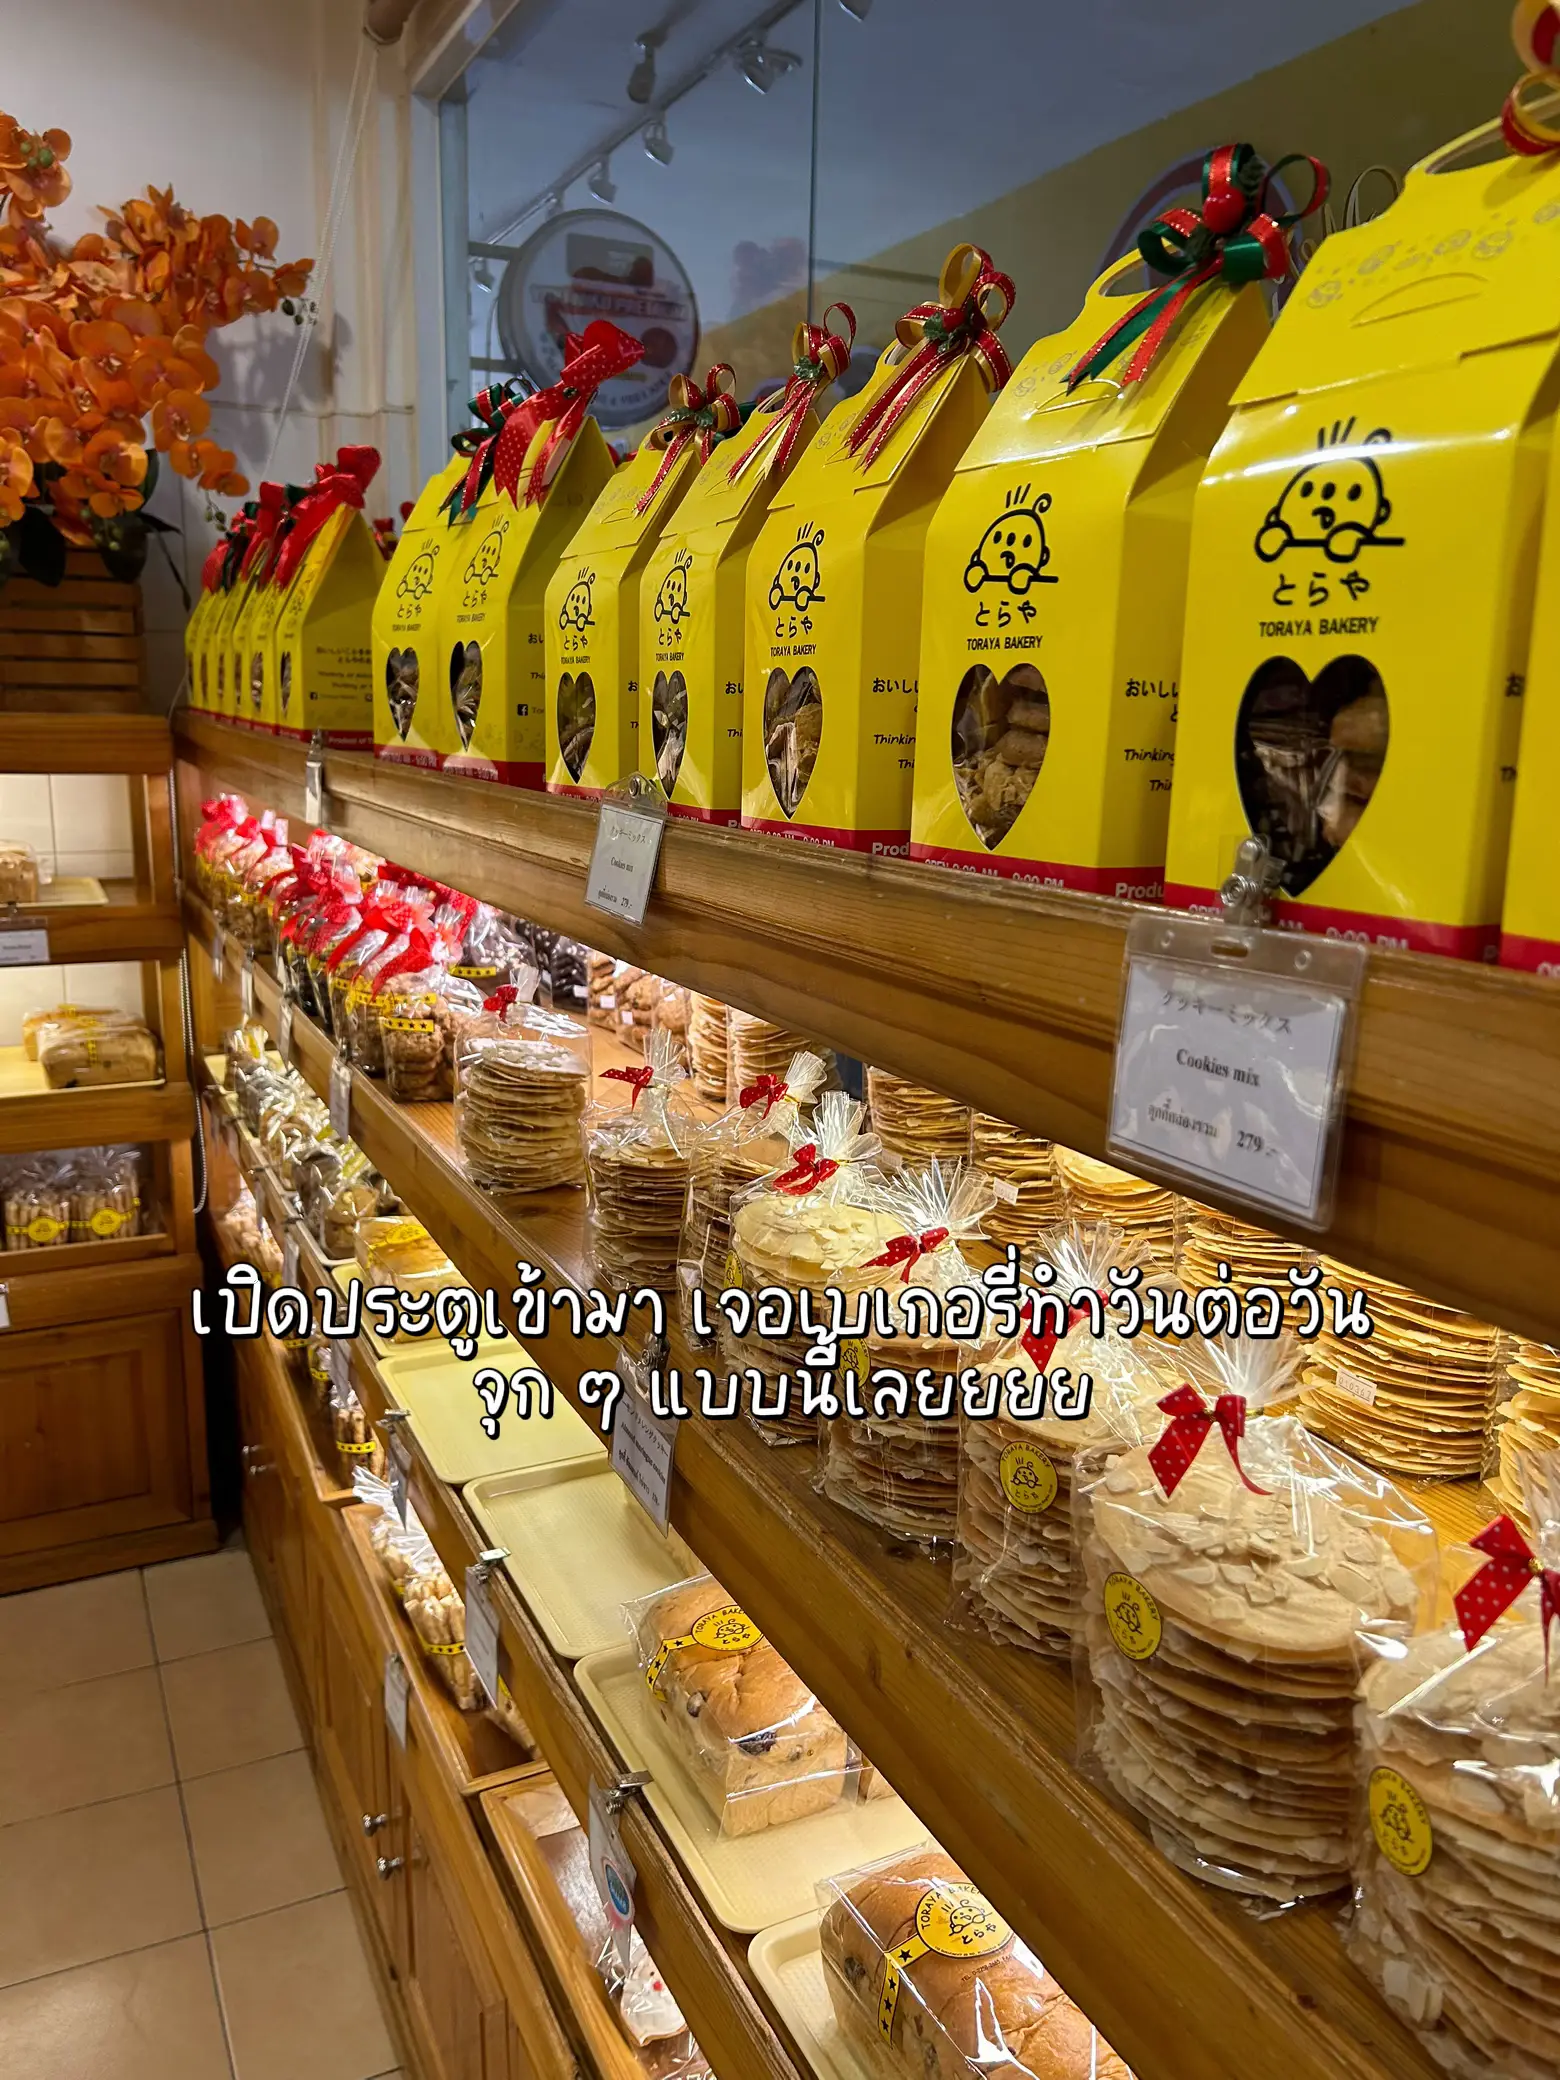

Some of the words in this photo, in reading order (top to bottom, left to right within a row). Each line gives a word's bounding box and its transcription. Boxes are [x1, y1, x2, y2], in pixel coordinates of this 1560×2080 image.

[462, 590, 488, 608] とらや
[1273, 570, 1371, 607] とらや
[396, 603, 422, 619] とらや
[974, 600, 1038, 628] とらや
[658, 628, 683, 646] とらや
[774, 616, 813, 638] とらや
[1258, 619, 1313, 638] TORAYA
[1318, 616, 1380, 636] BAKERY
[563, 635, 588, 651] とらや
[770, 646, 791, 658] TORAYA
[793, 643, 817, 656] BAKERY
[966, 637, 1001, 651] TORAYA
[1003, 635, 1043, 649] BAKERY
[669, 652, 684, 662] BAKERY
[1161, 988, 1293, 1035] クッキーミックス
[1175, 1047, 1230, 1079] Cookies
[1232, 1065, 1261, 1088] mix
[1001, 1442, 1023, 1462] TORAYA
[1025, 1443, 1052, 1468] BAKERY
[695, 1613, 718, 1634] TORAYA
[920, 1891, 941, 1931] TORAYA
[961, 1922, 997, 1945] とらや
